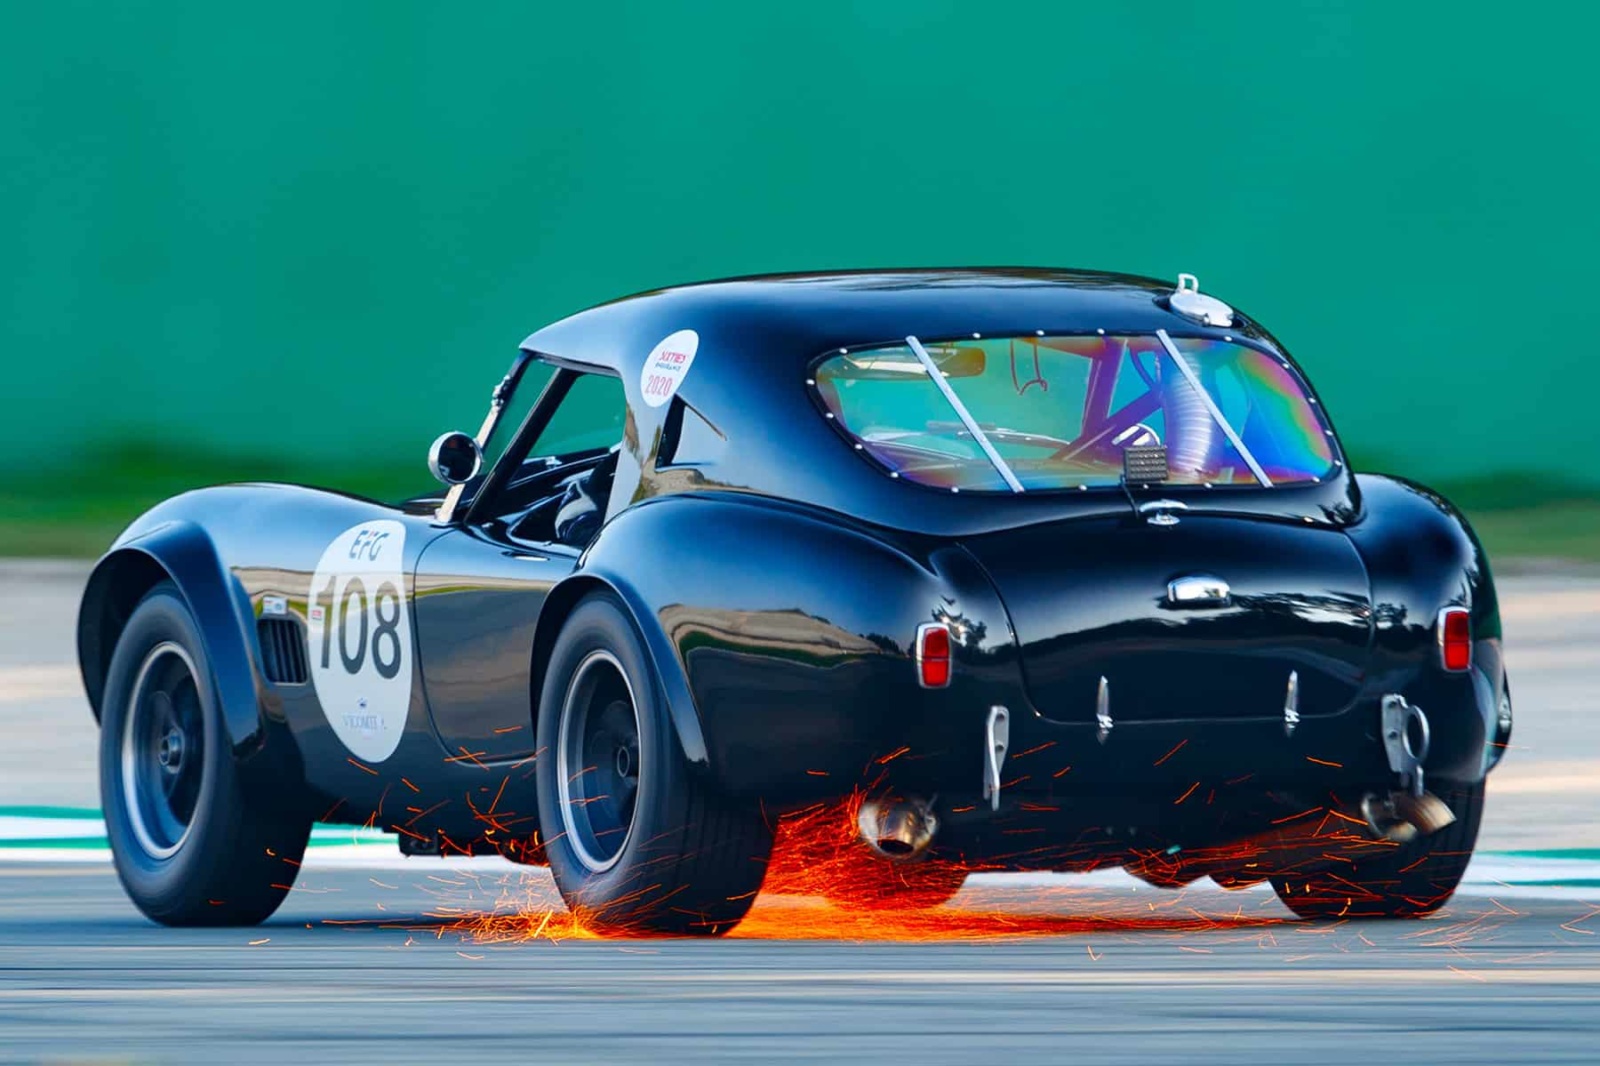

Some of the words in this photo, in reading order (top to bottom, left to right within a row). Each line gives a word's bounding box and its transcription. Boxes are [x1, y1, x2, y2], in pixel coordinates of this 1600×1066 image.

[644, 375, 673, 396] 2020
[349, 530, 389, 561] EFG
[316, 576, 401, 679] 108
